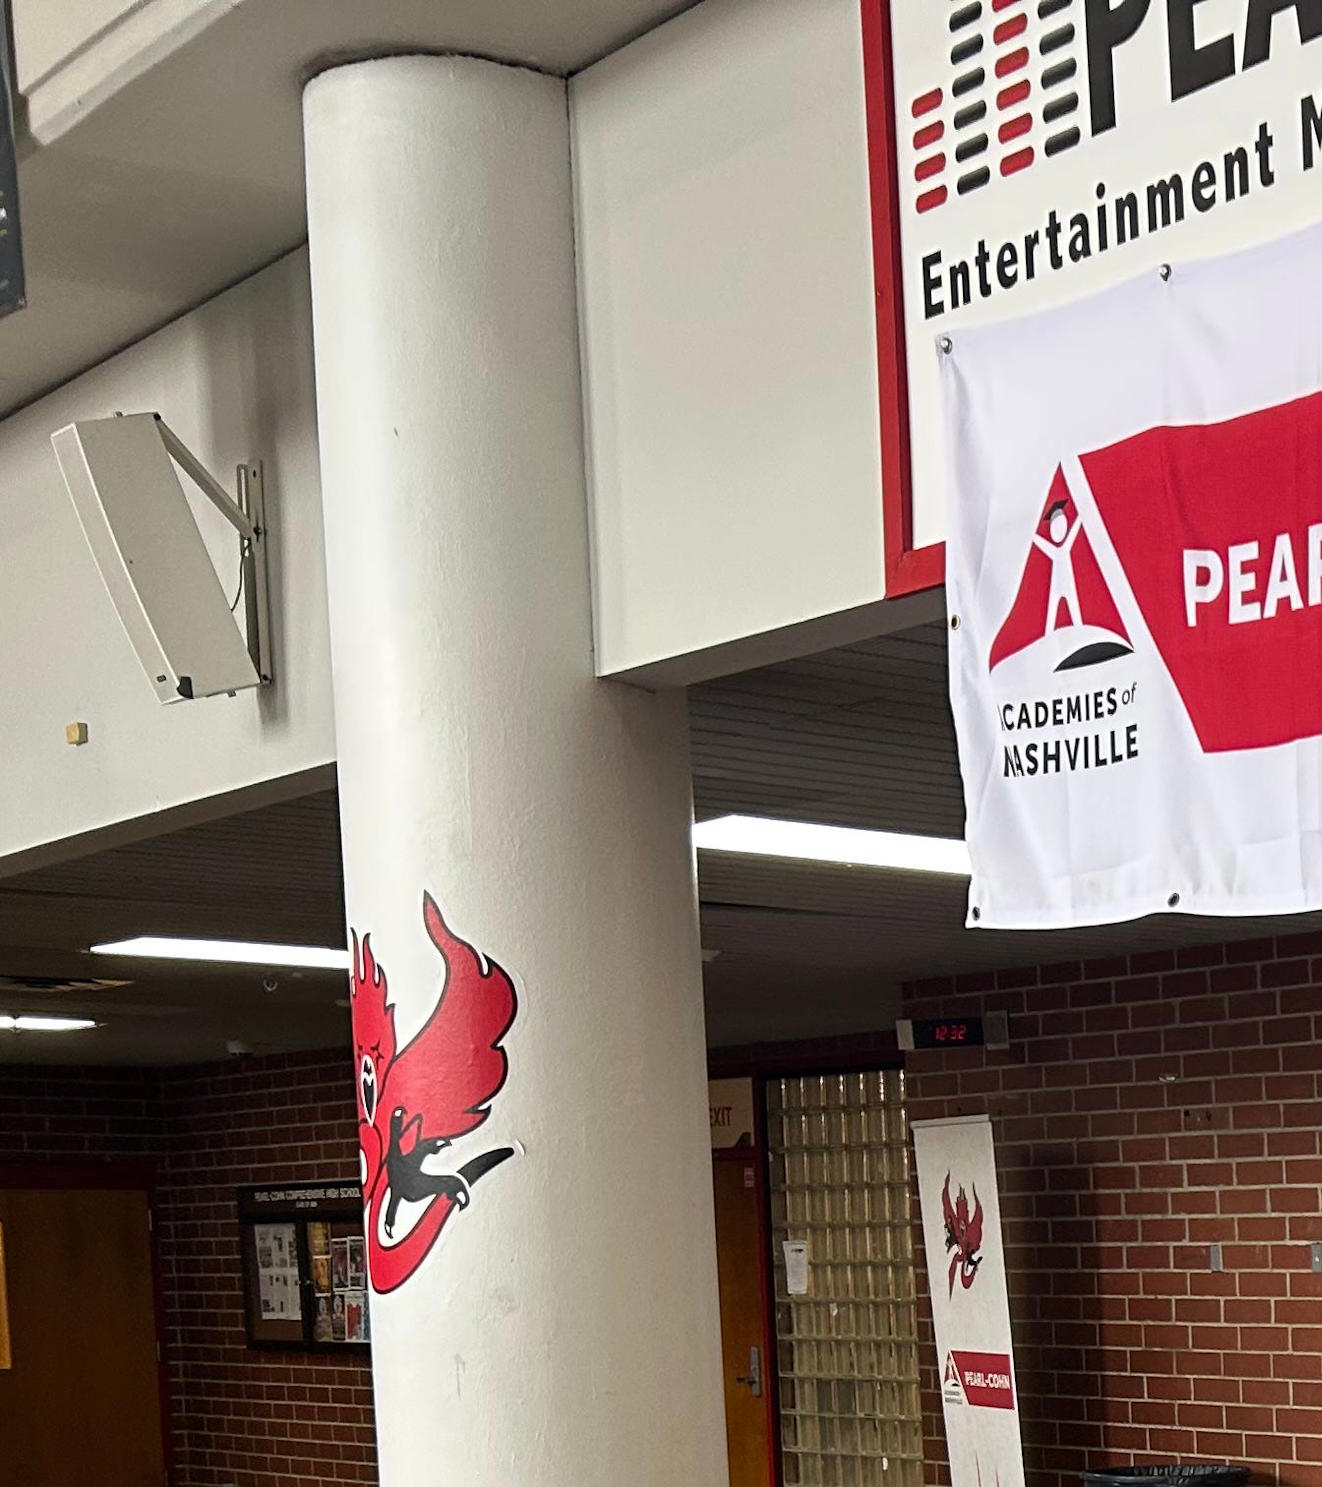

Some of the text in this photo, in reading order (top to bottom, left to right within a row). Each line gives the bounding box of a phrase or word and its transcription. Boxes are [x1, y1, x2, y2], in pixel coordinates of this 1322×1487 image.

[921, 121, 1274, 320] Entertainment
[997, 681, 1138, 731] CADEMIES of
